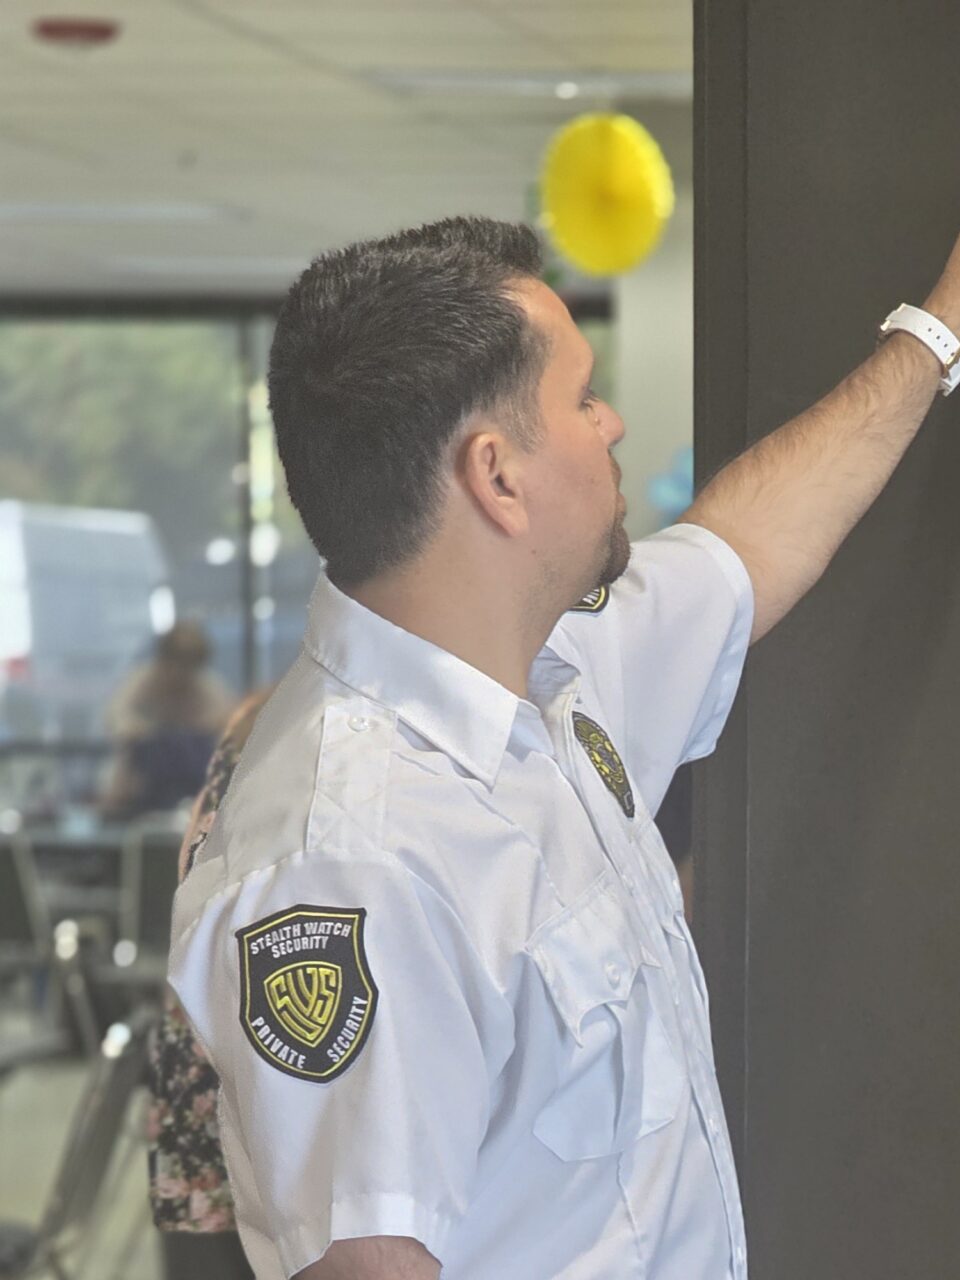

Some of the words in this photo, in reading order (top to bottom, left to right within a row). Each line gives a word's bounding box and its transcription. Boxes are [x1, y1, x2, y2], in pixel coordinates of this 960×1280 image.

[250, 923, 301, 954] STEALTH
[303, 922, 352, 938] WATCH
[271, 936, 329, 958] SECURITY
[252, 1017, 307, 1069] PRIVATE
[327, 996, 368, 1063] SECURITY
